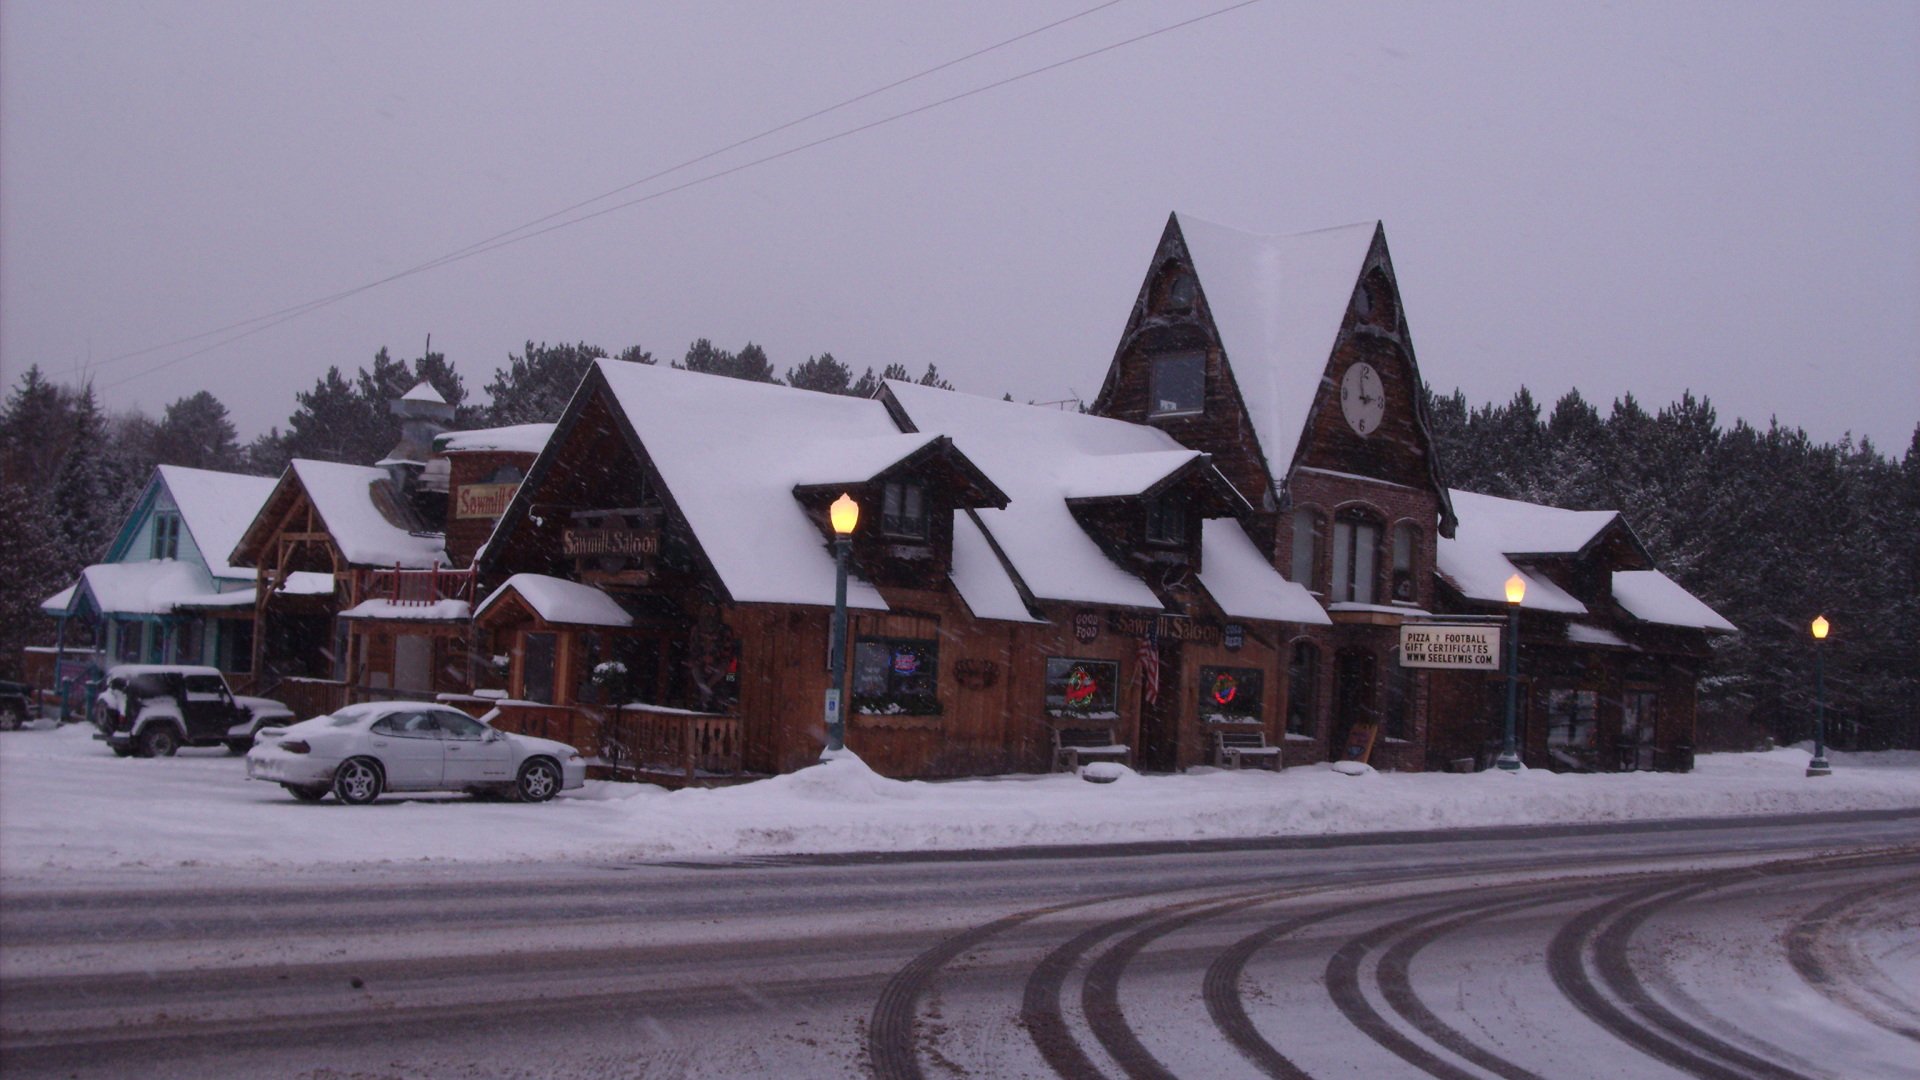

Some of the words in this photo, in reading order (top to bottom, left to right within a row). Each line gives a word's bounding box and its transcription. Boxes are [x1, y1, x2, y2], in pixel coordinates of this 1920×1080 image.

[1378, 396, 1384, 409] 3
[1359, 419, 1365, 432] 6
[460, 487, 505, 514] Sawmill
[564, 529, 609, 554] Sawmill
[612, 532, 657, 554] Saloon
[1075, 614, 1098, 625] GOOD
[1076, 626, 1097, 639] FOOD
[1171, 616, 1219, 642] Saloon
[1408, 634, 1429, 642] PIZZA
[1445, 634, 1486, 643] FOOTBALL
[1405, 643, 1423, 652] GIFT
[1427, 644, 1488, 654] CERTIFICATES
